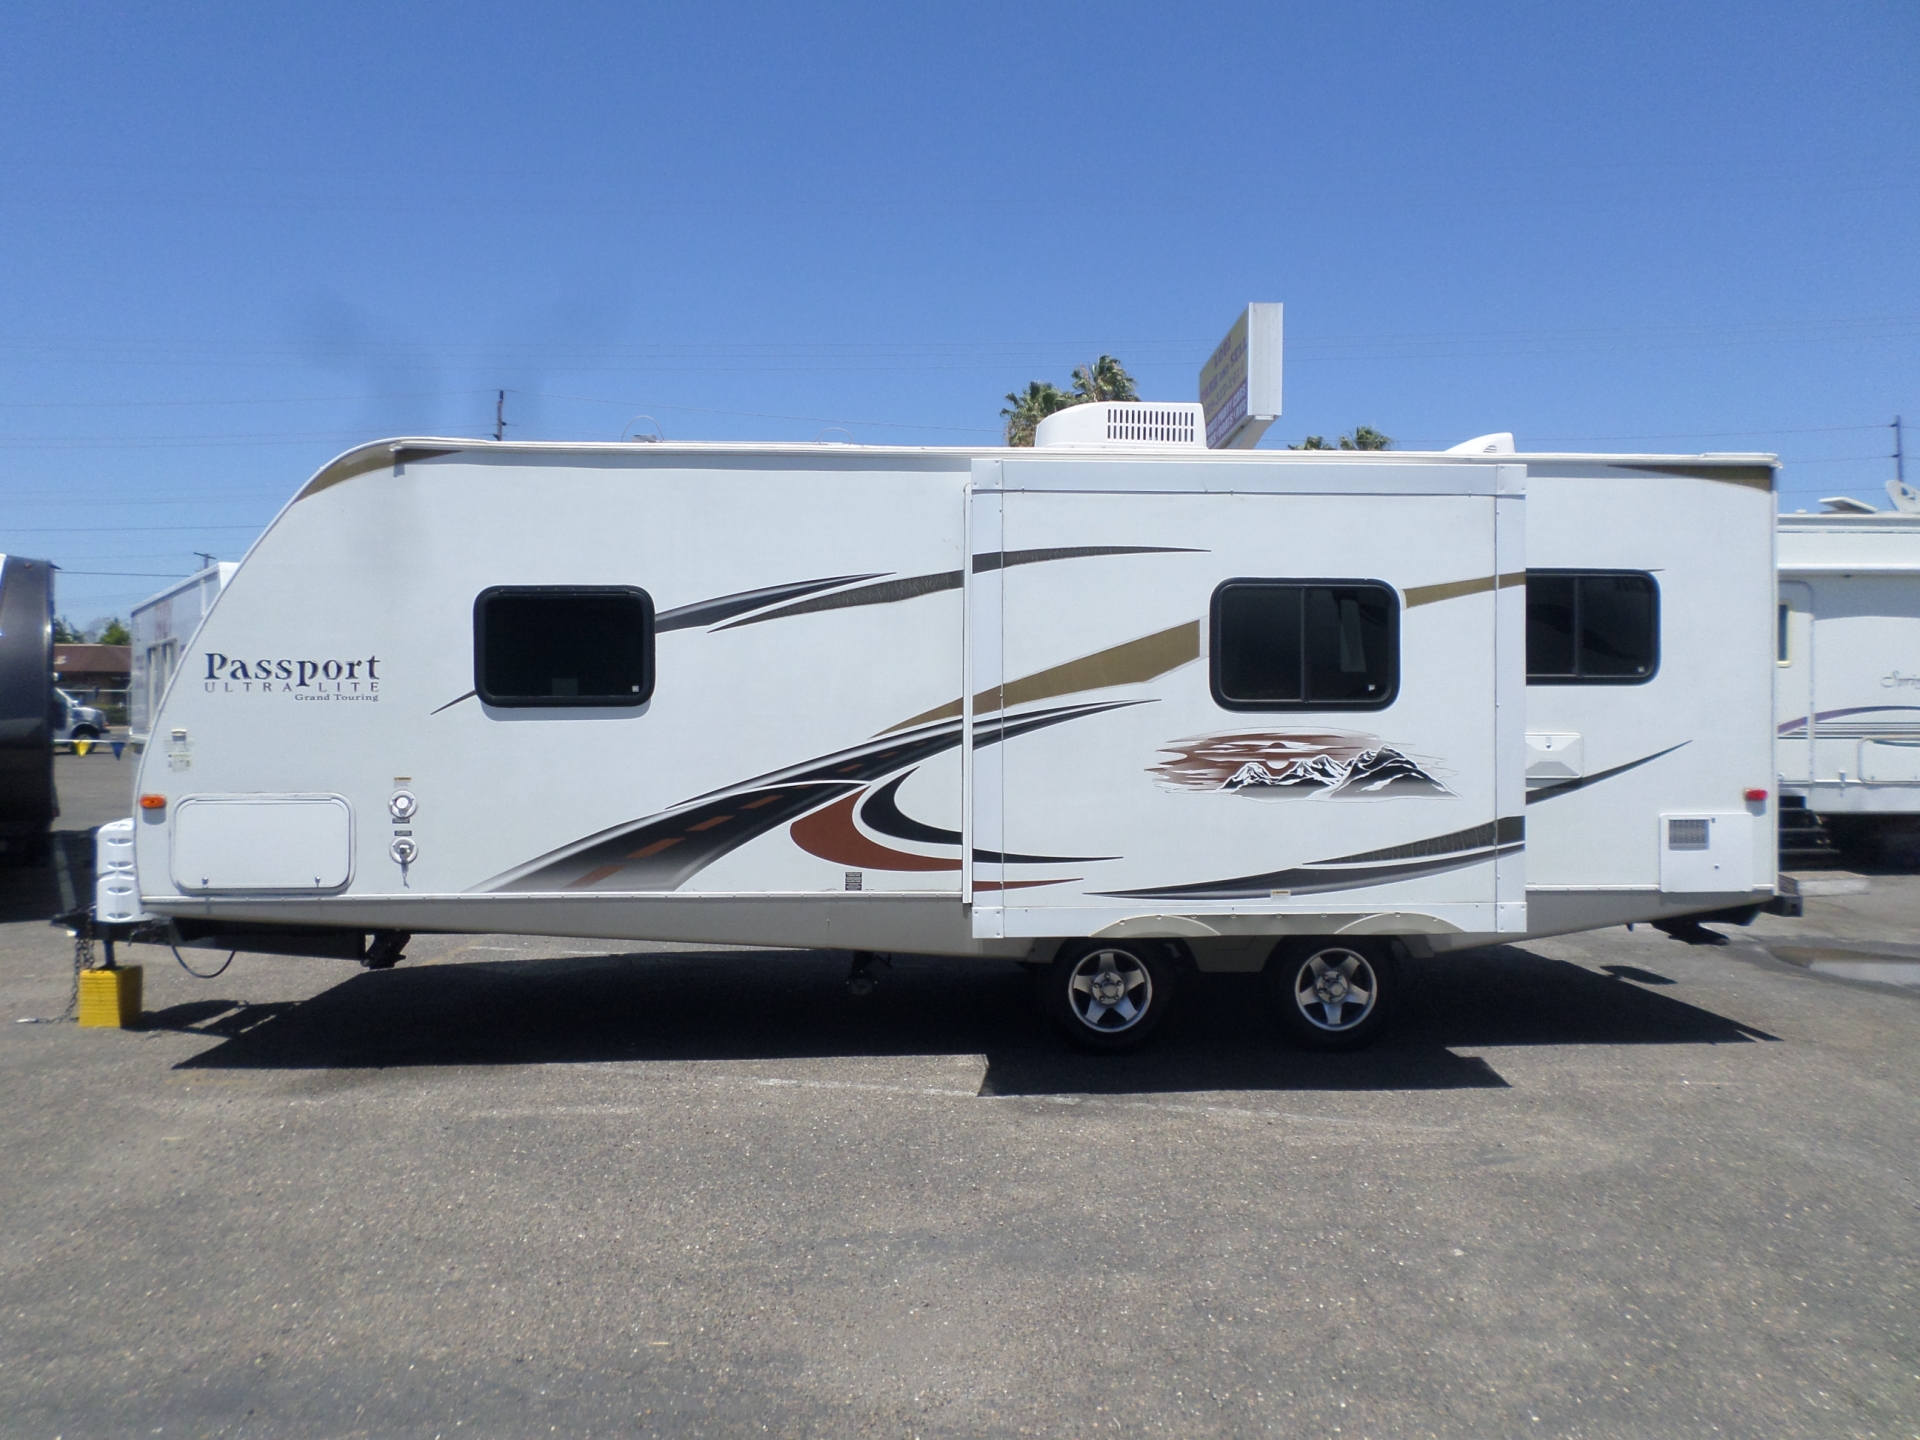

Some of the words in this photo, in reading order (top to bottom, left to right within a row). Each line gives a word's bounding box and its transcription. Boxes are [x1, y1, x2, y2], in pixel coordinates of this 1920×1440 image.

[204, 653, 380, 687] Passport
[295, 693, 330, 702] Grand
[334, 693, 380, 702] Touring
